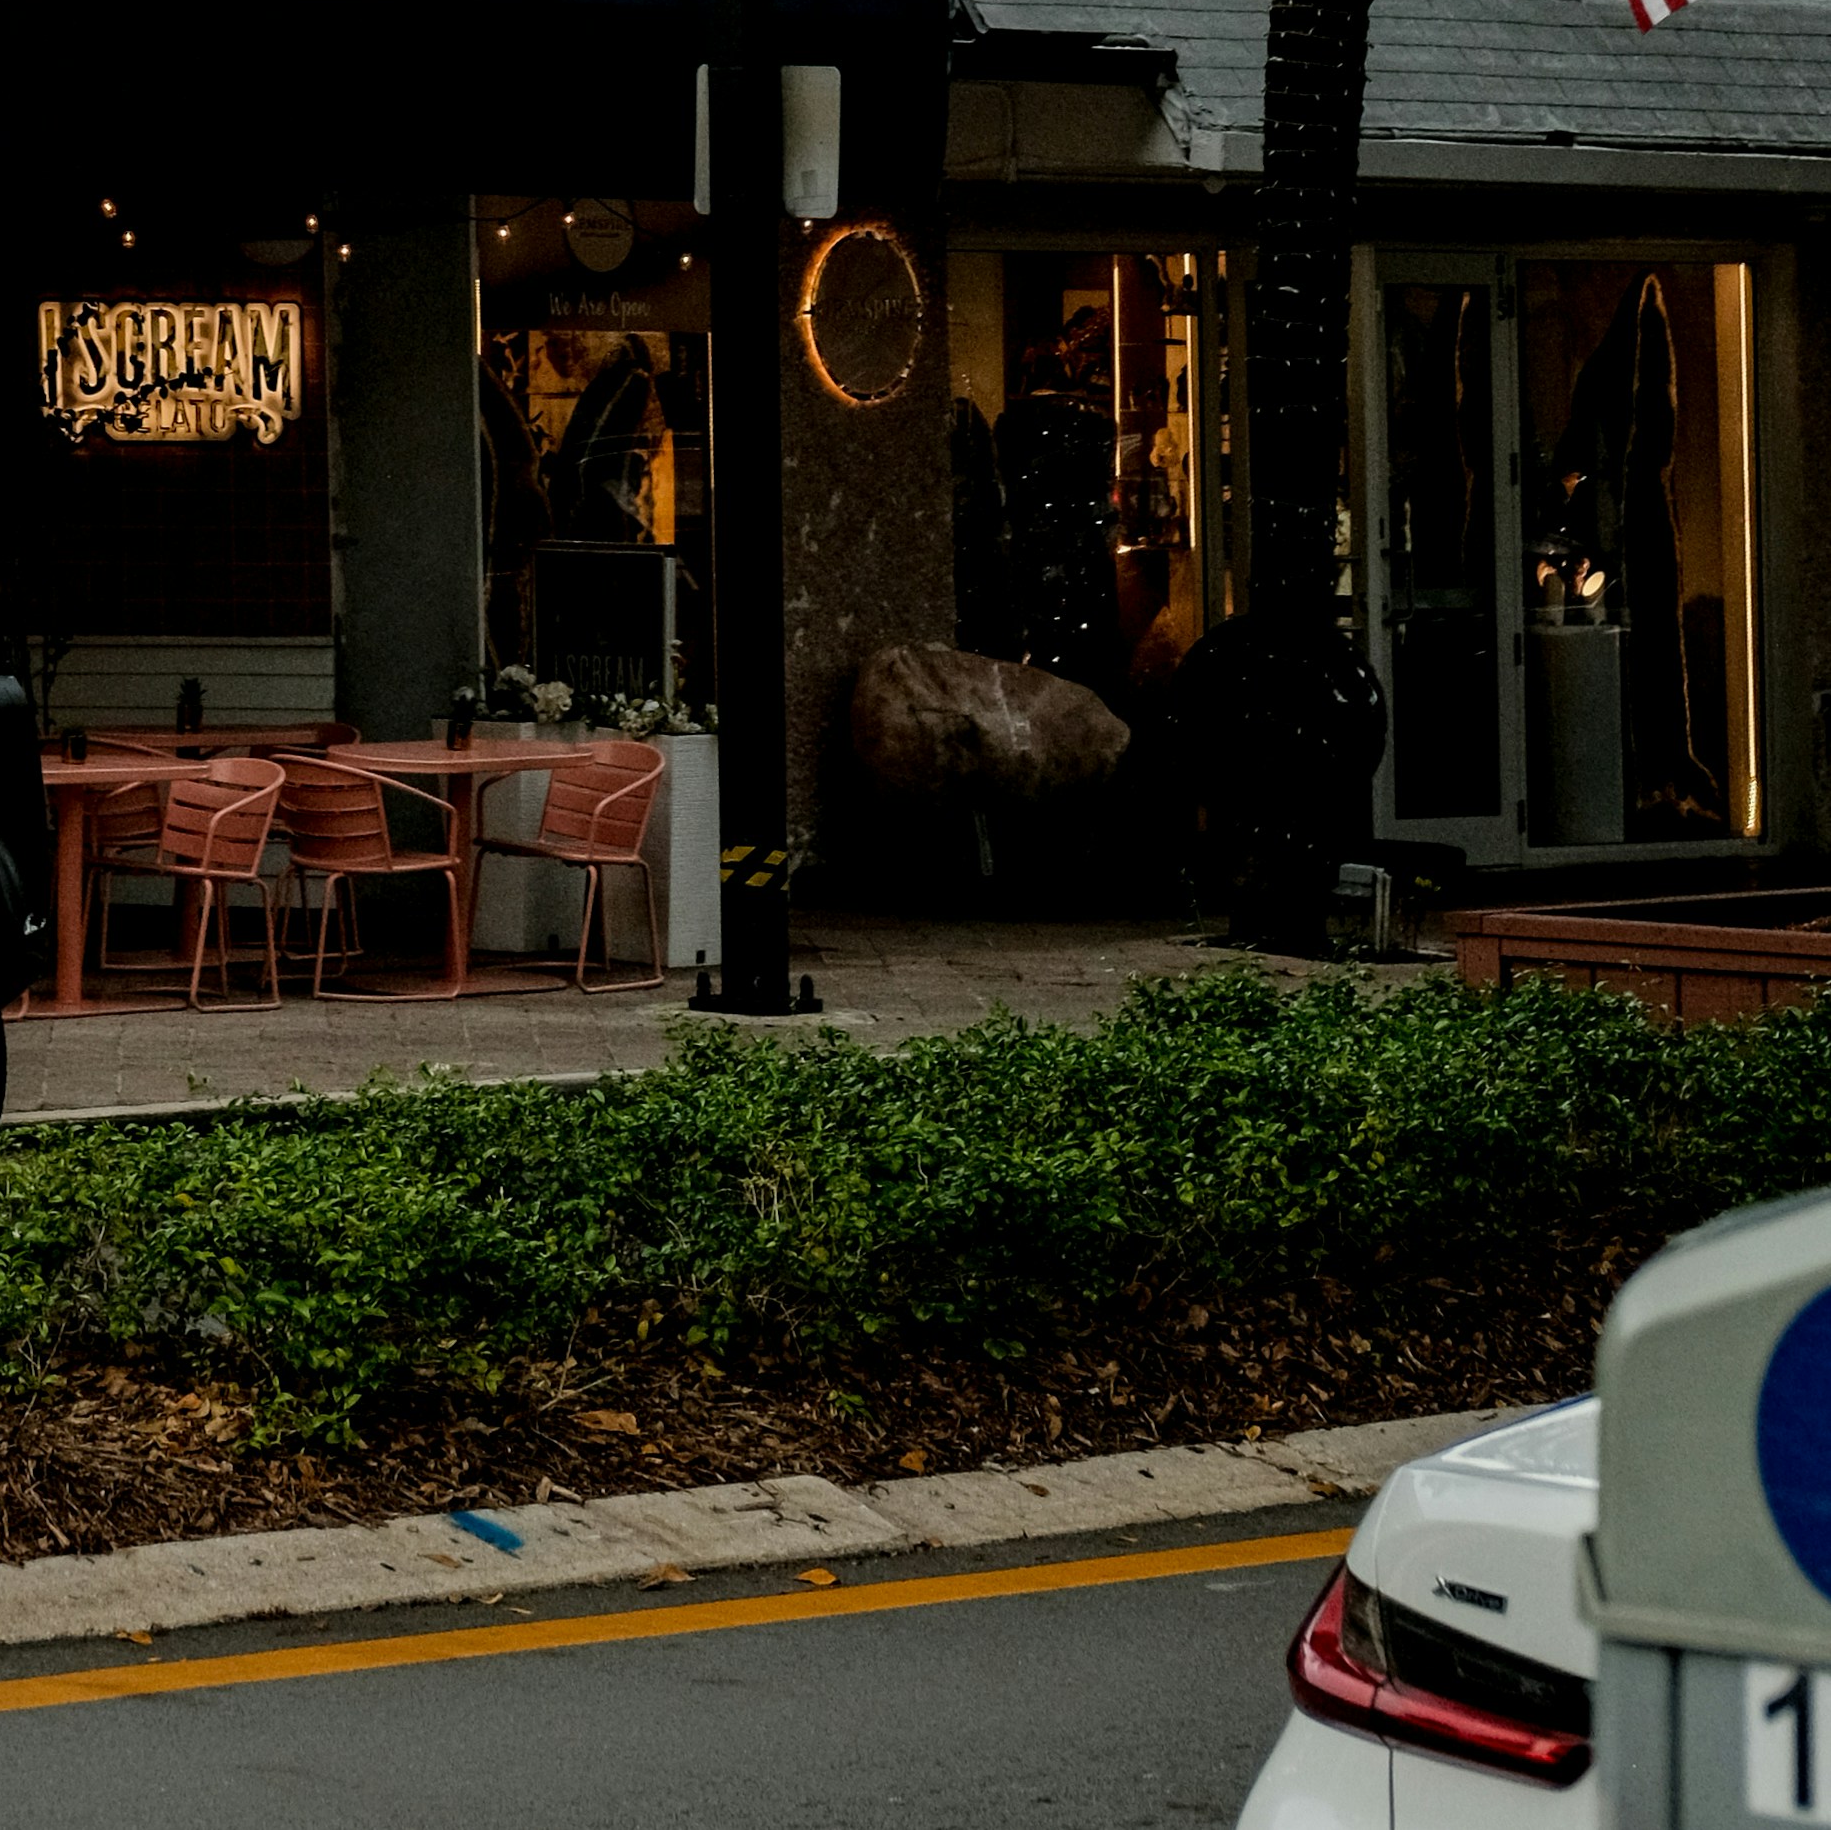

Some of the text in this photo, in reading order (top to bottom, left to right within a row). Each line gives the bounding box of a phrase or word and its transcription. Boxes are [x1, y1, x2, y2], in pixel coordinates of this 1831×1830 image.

[549, 291, 651, 329] We Are Open
[77, 306, 296, 412] SCREAM
[112, 399, 229, 435] GELATO
[566, 653, 645, 697] SCREAM
